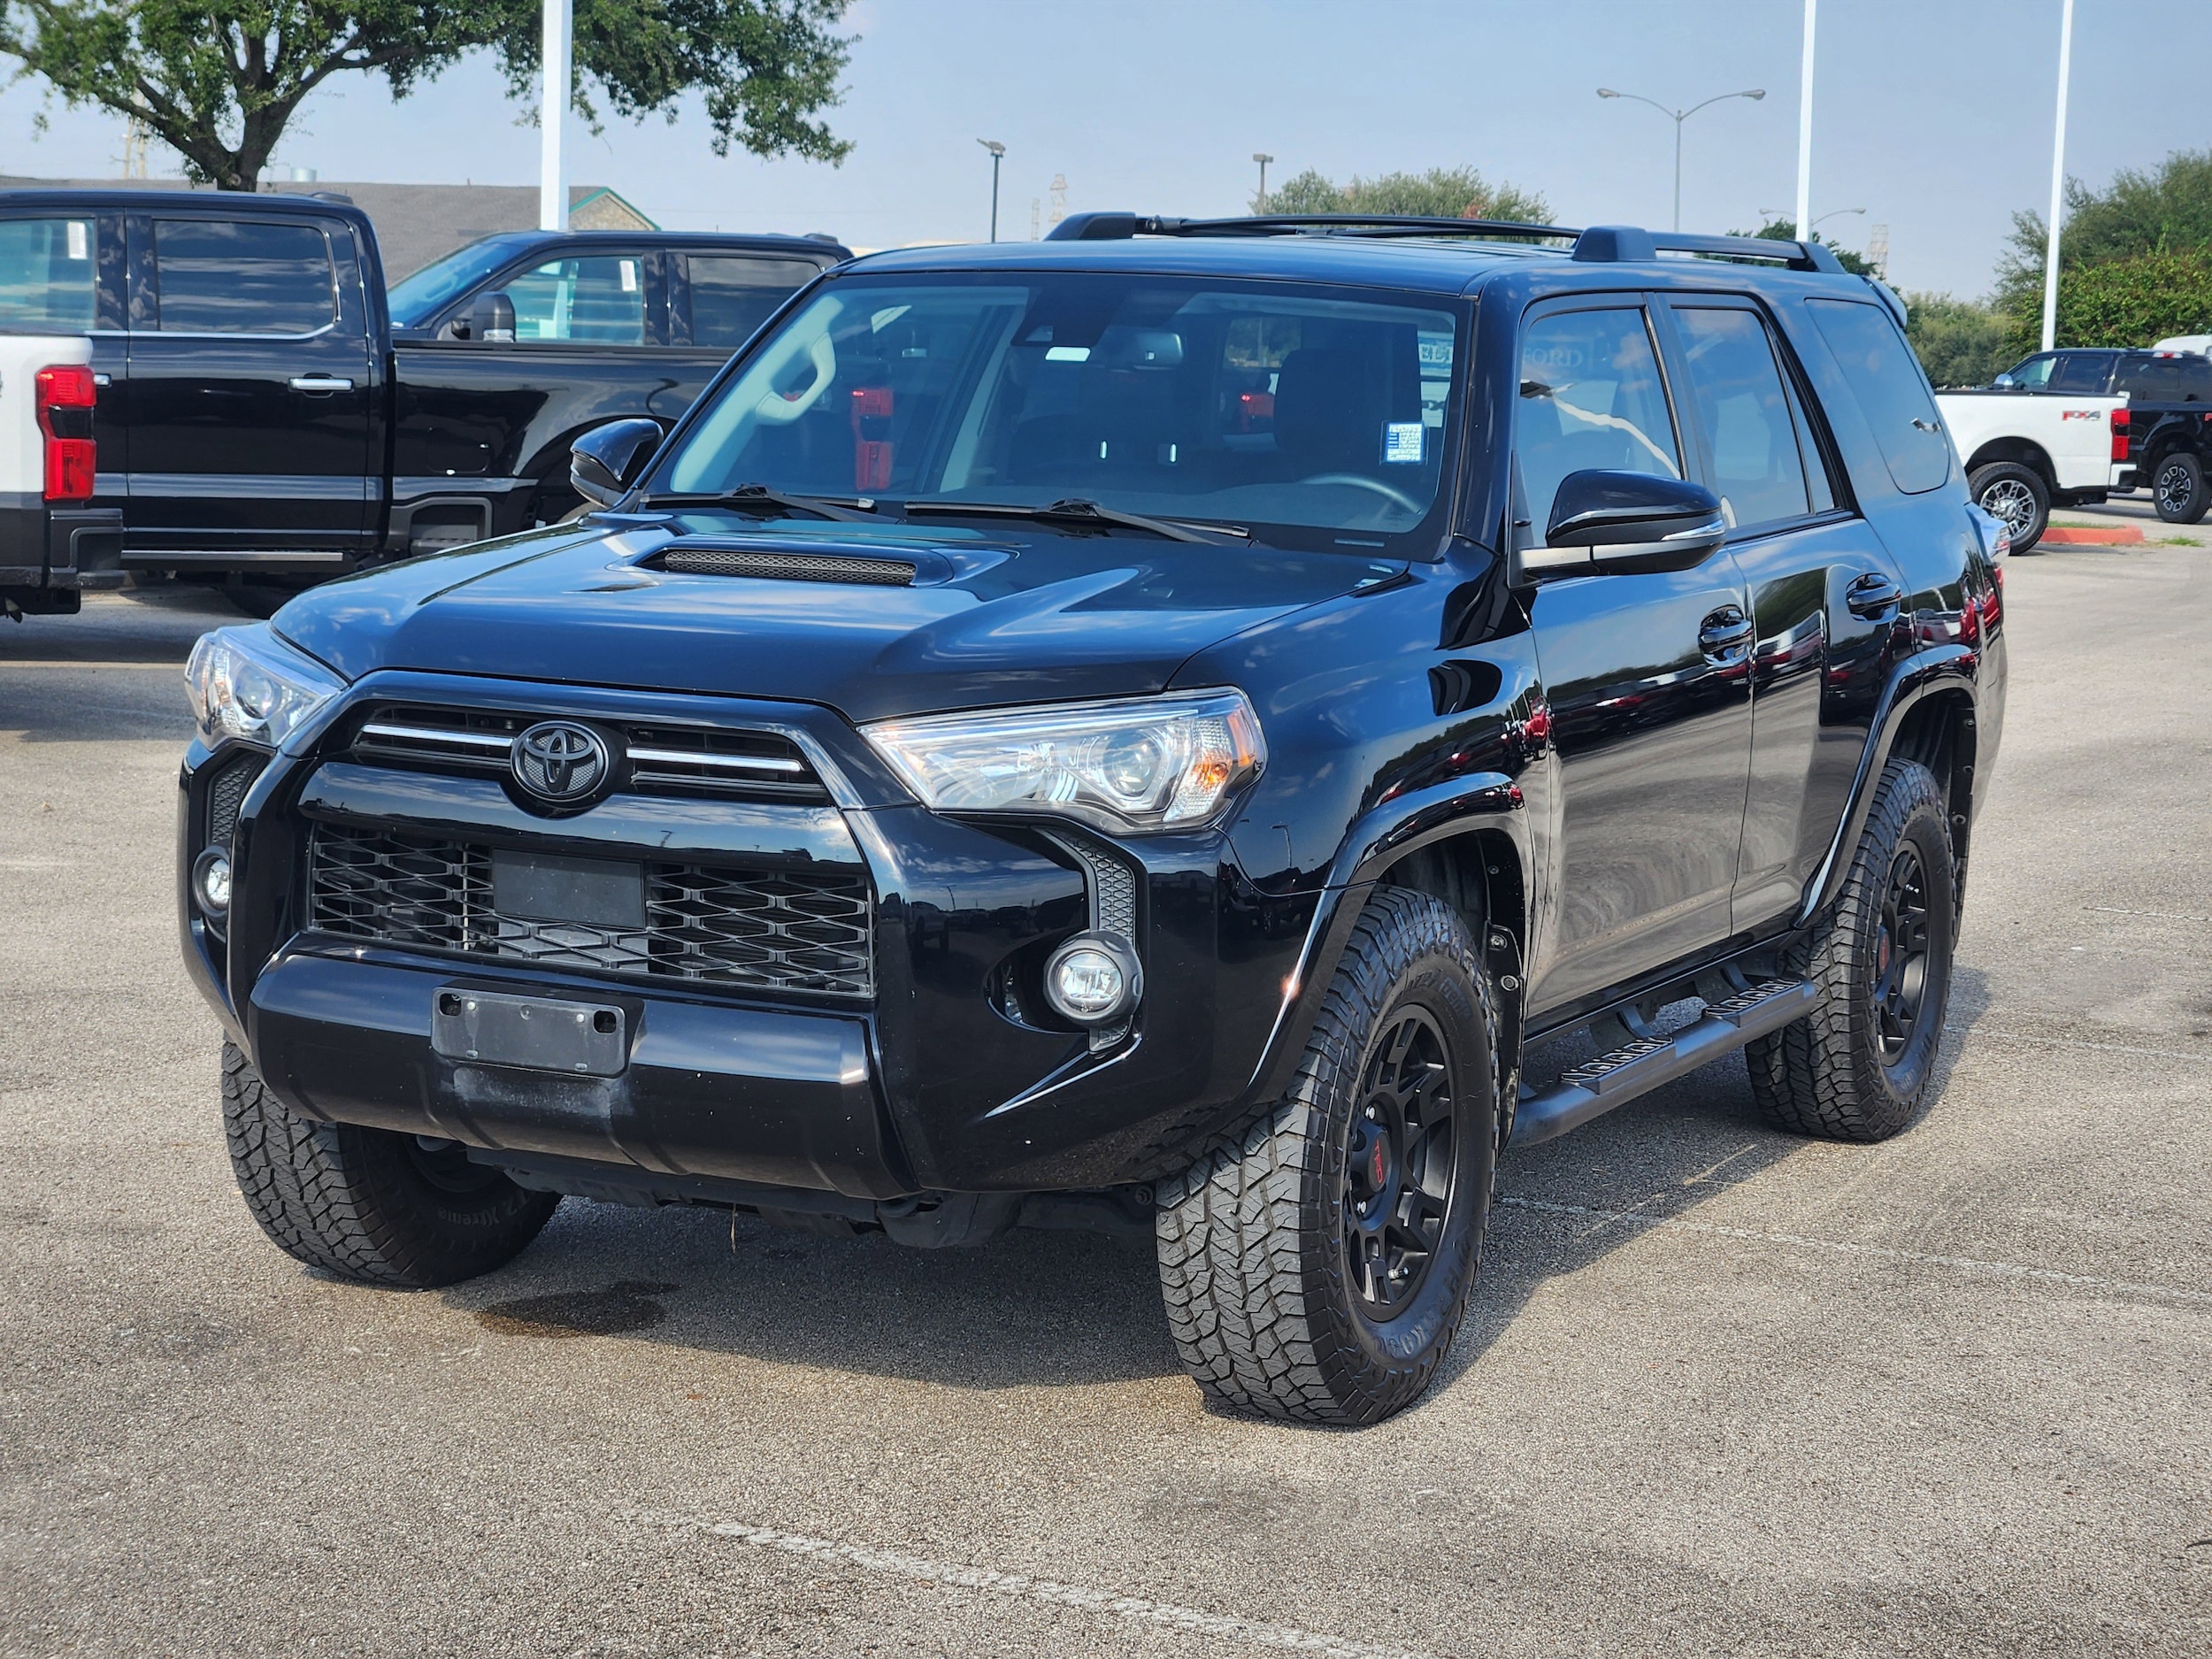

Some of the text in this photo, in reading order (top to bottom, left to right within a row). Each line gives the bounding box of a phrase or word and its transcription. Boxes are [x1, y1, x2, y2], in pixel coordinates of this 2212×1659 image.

[1522, 347, 1584, 367] FORD
[2062, 411, 2101, 421] FX4
[1374, 1138, 1385, 1184] TRD
